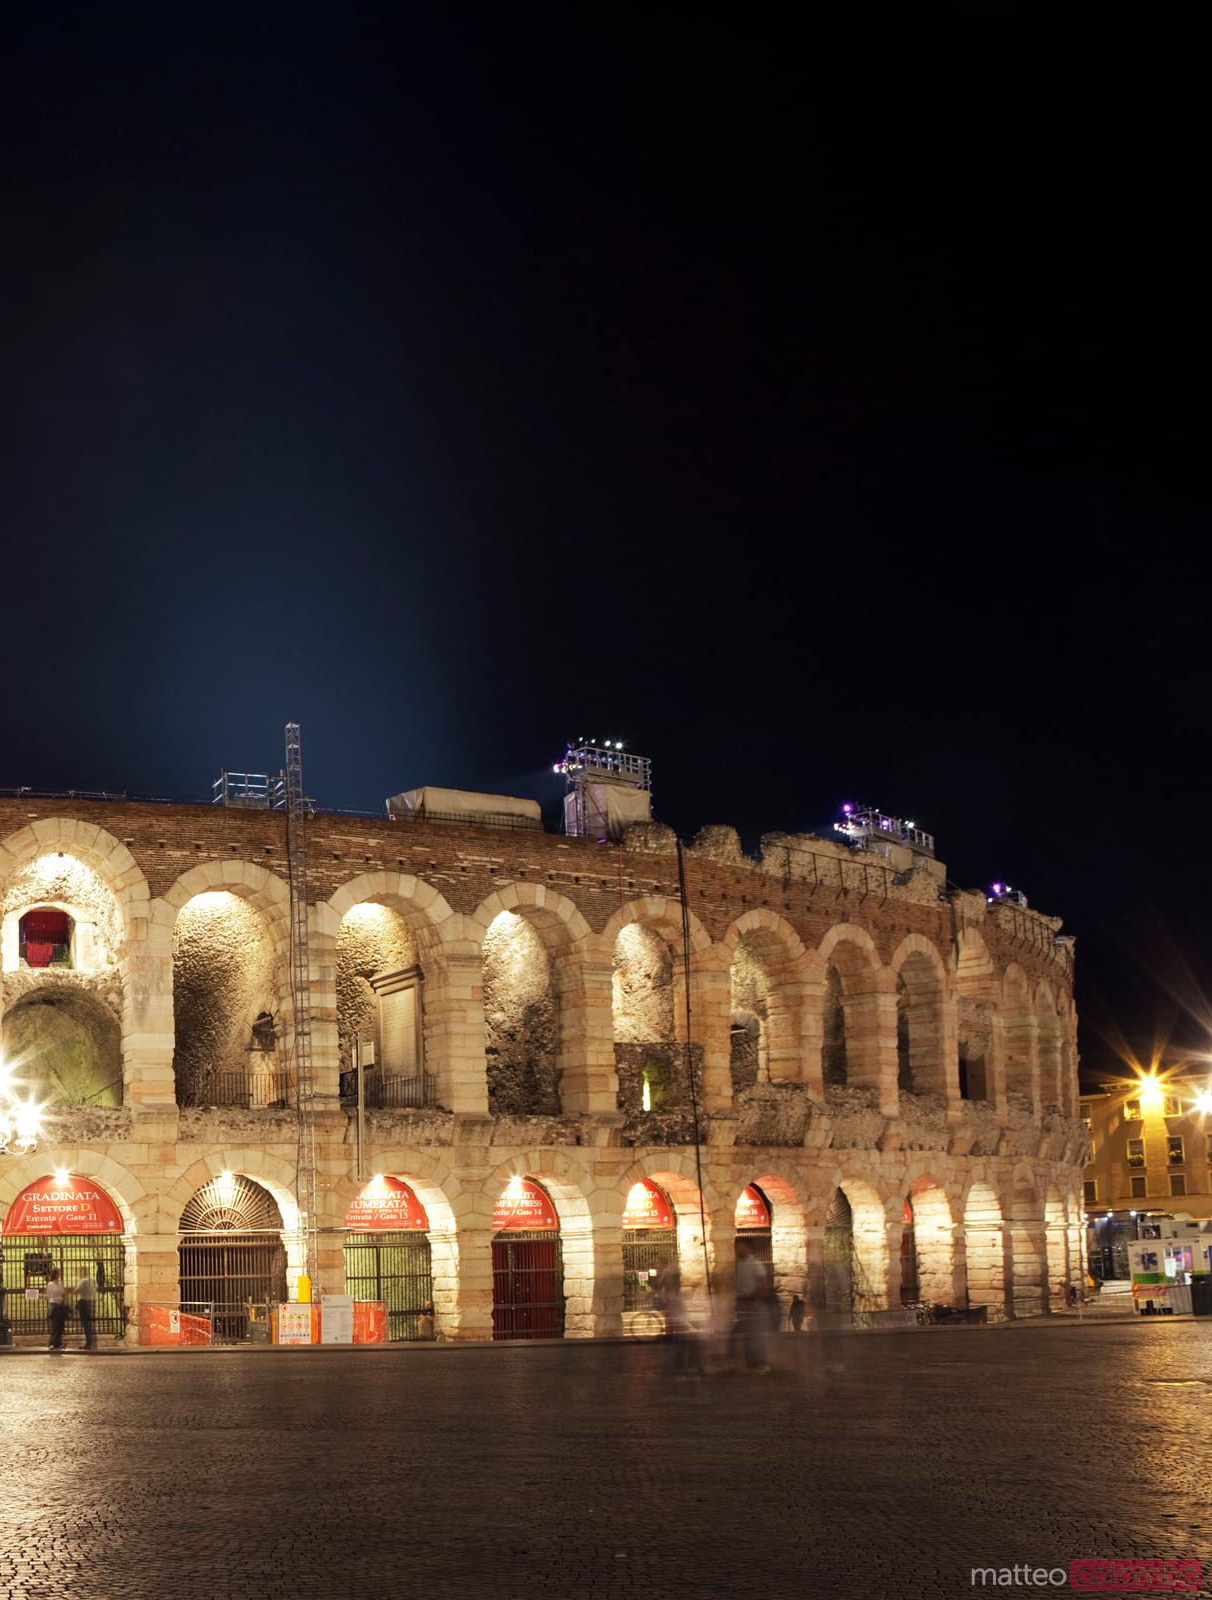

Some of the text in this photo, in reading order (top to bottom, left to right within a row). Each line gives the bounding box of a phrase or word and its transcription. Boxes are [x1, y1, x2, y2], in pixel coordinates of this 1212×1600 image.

[22, 1191, 100, 1202] GRADINATA
[80, 1203, 91, 1212] D
[520, 1200, 543, 1208] PRESS
[26, 1214, 57, 1222] Entrata
[65, 1213, 87, 1221] Gate
[88, 1213, 98, 1221] 11
[379, 1212, 398, 1220] Gate
[399, 1211, 408, 1219] 13
[650, 1209, 659, 1217] 15
